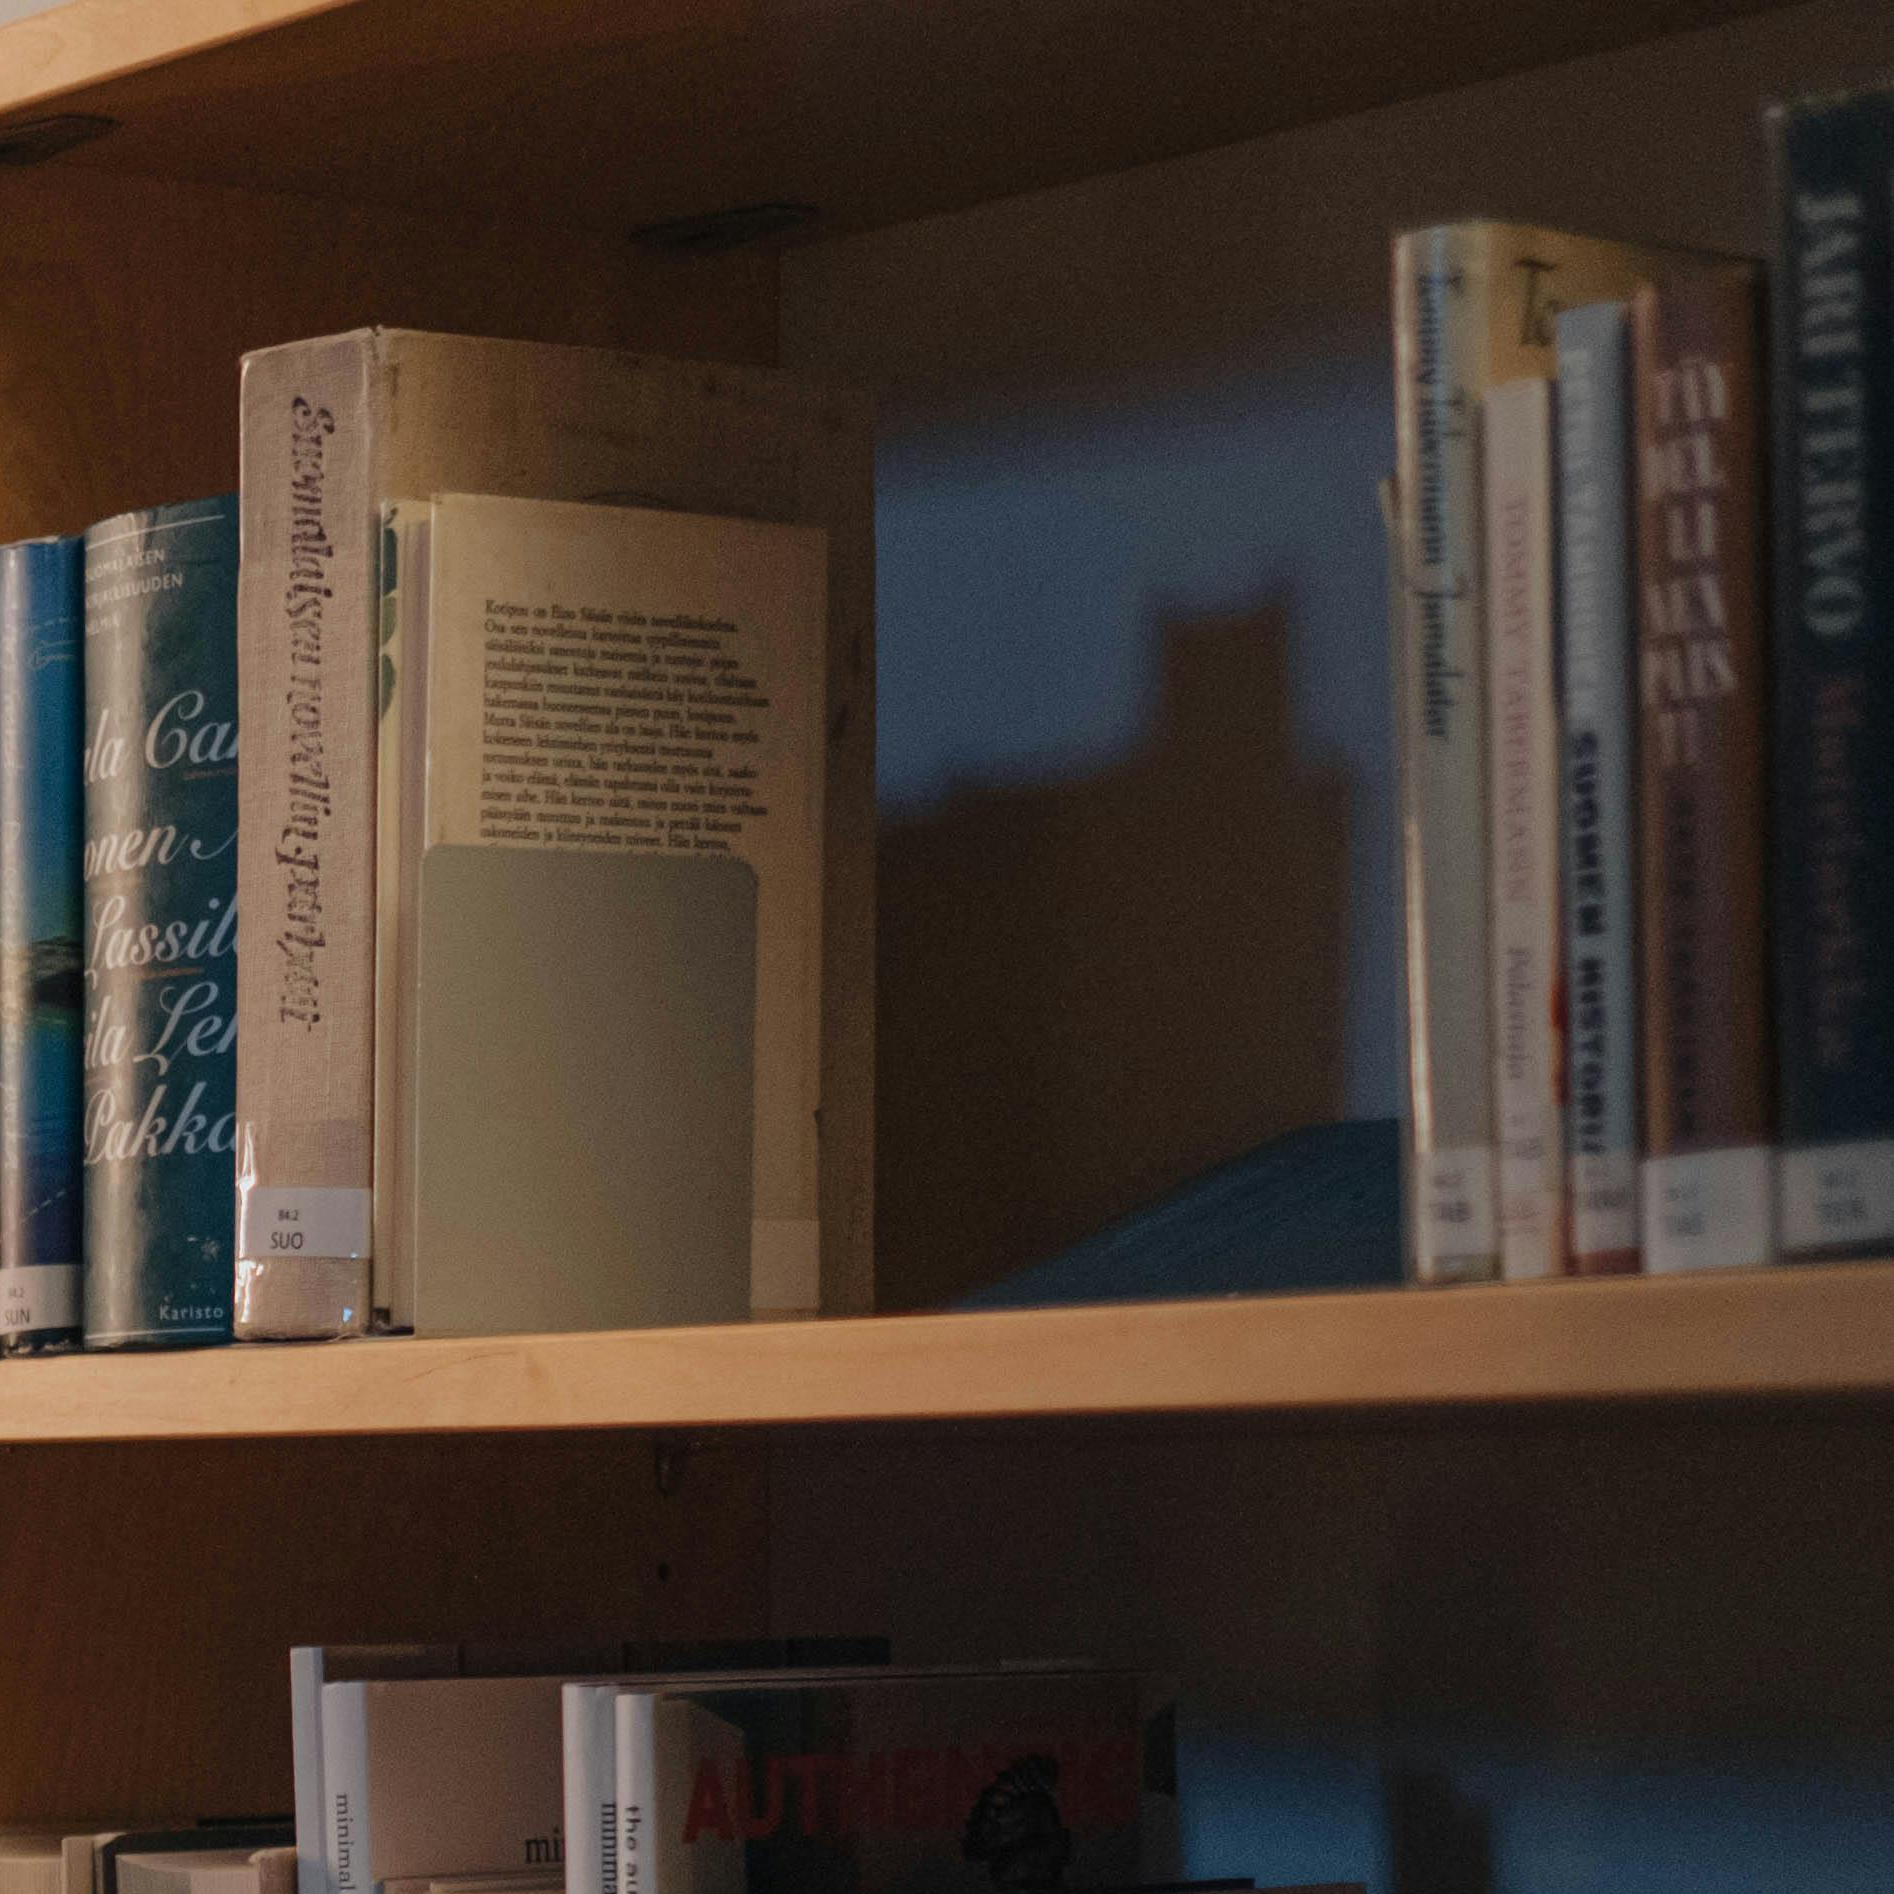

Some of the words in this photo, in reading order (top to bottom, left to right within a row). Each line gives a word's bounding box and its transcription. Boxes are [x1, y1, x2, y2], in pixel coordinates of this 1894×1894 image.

[1796, 194, 1863, 356] JARI
[285, 396, 336, 666] Suomalaisen
[1803, 368, 1865, 636] TERVO
[283, 676, 333, 843] novellin
[1573, 731, 1604, 936] SUOMEN
[86, 894, 239, 990] Lassil
[269, 1231, 305, 1250] SUO
[3, 1309, 31, 1325] SUN
[158, 1303, 224, 1321] Karisto
[334, 1793, 358, 1892] minimal
[624, 1805, 646, 1855] the
